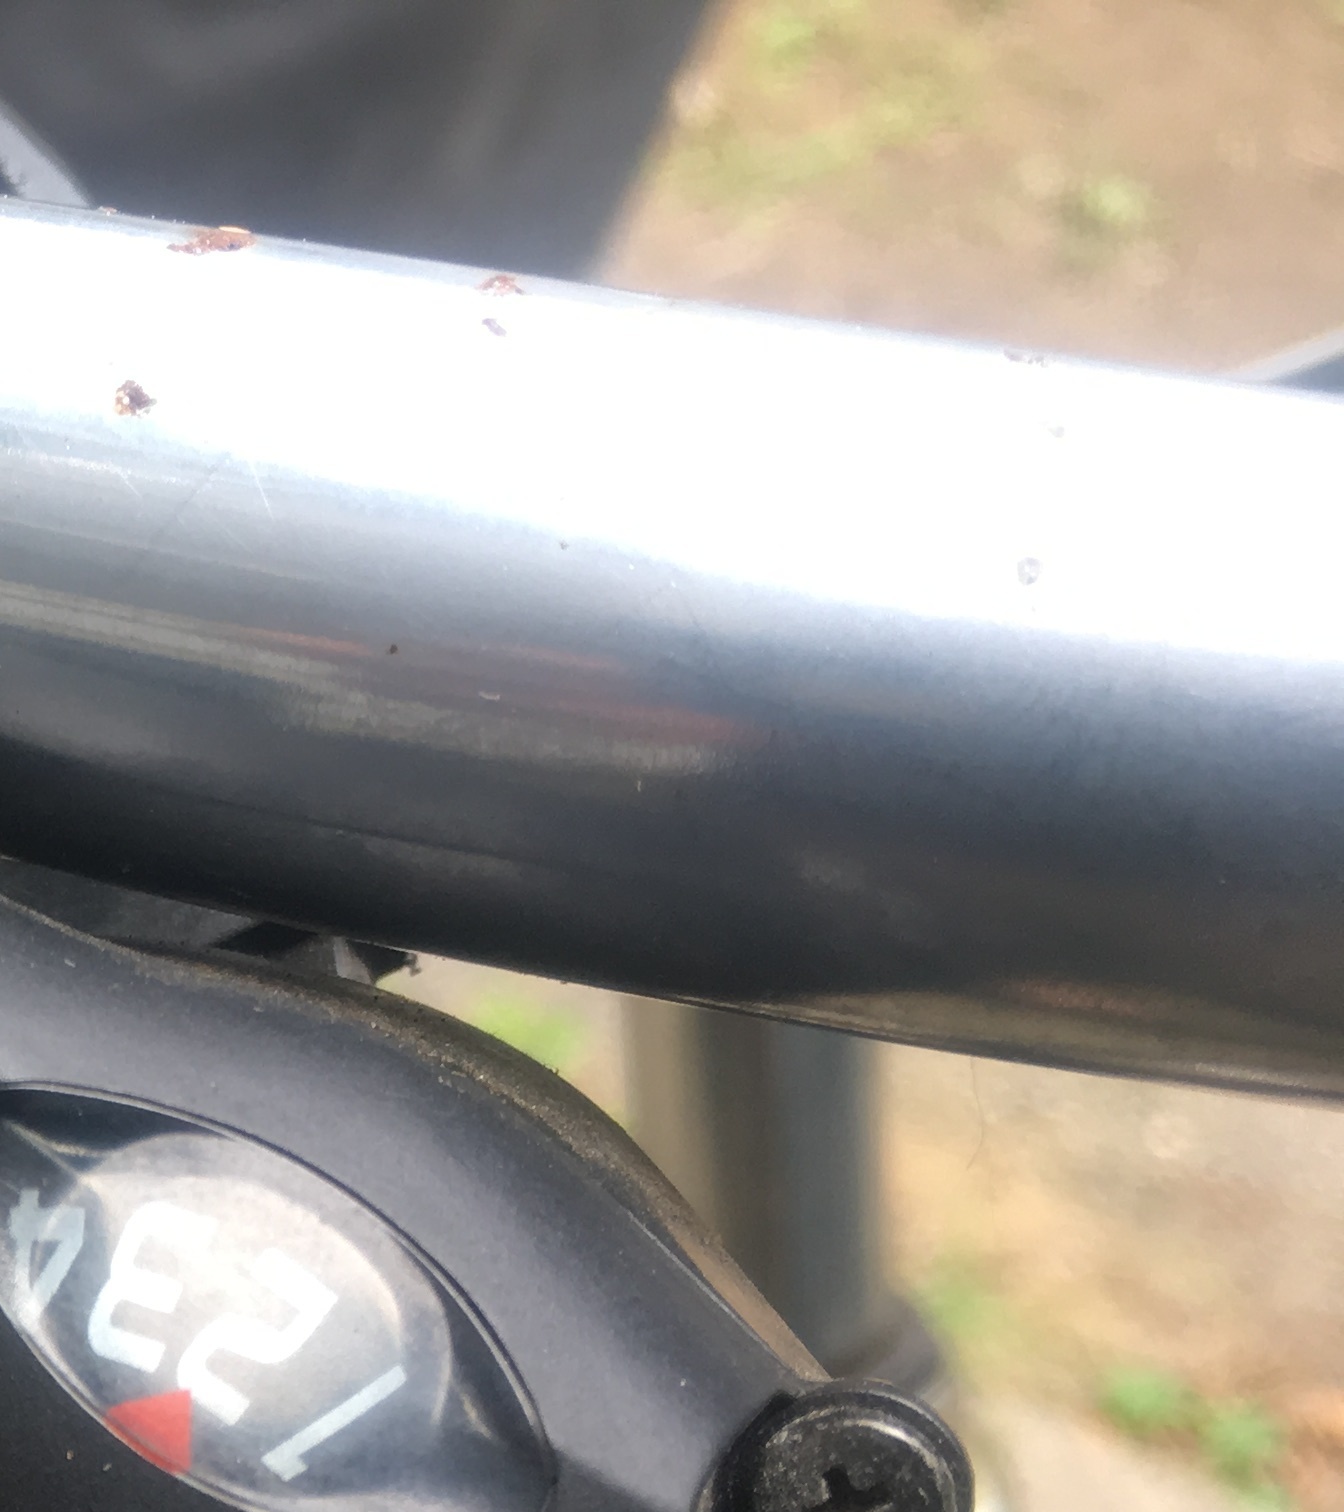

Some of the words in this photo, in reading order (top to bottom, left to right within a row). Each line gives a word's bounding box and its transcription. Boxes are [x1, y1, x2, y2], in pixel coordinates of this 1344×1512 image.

[8, 1188, 86, 1309] 4
[87, 1200, 216, 1374] 3
[177, 1248, 339, 1426] 2
[261, 1364, 407, 1482] 1
